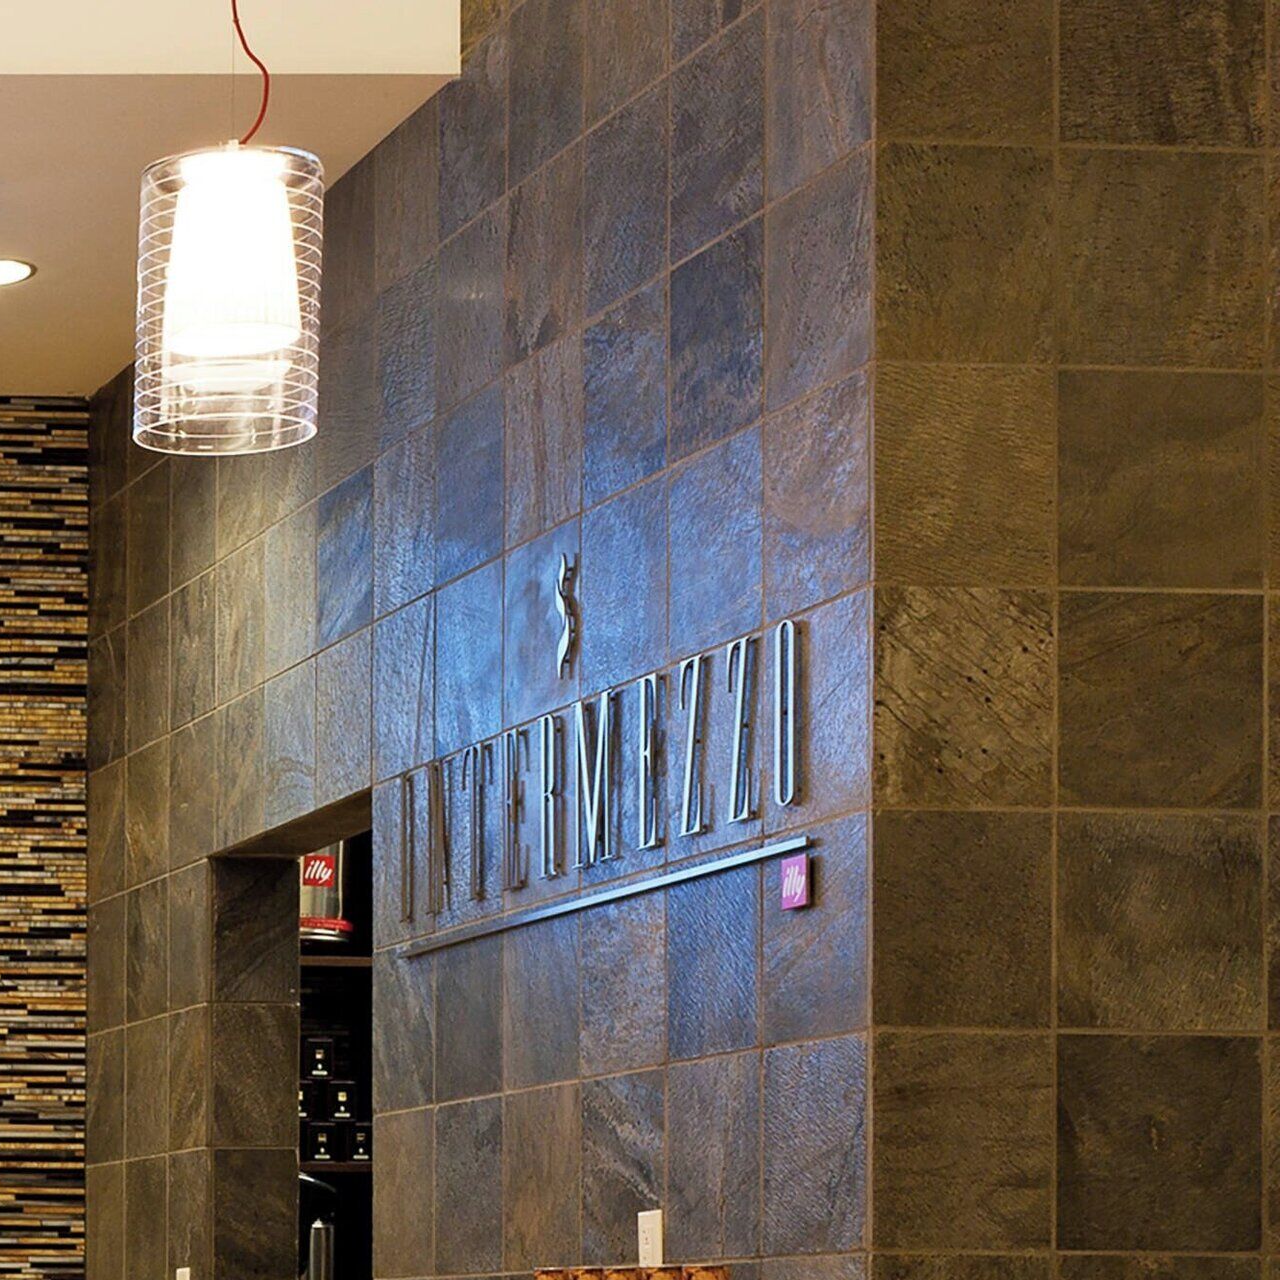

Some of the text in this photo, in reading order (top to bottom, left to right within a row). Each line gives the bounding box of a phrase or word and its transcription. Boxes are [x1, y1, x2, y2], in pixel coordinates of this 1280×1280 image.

[400, 619, 797, 922] INTERMEZZO
[304, 859, 333, 884] illy
[782, 864, 805, 902] illy
